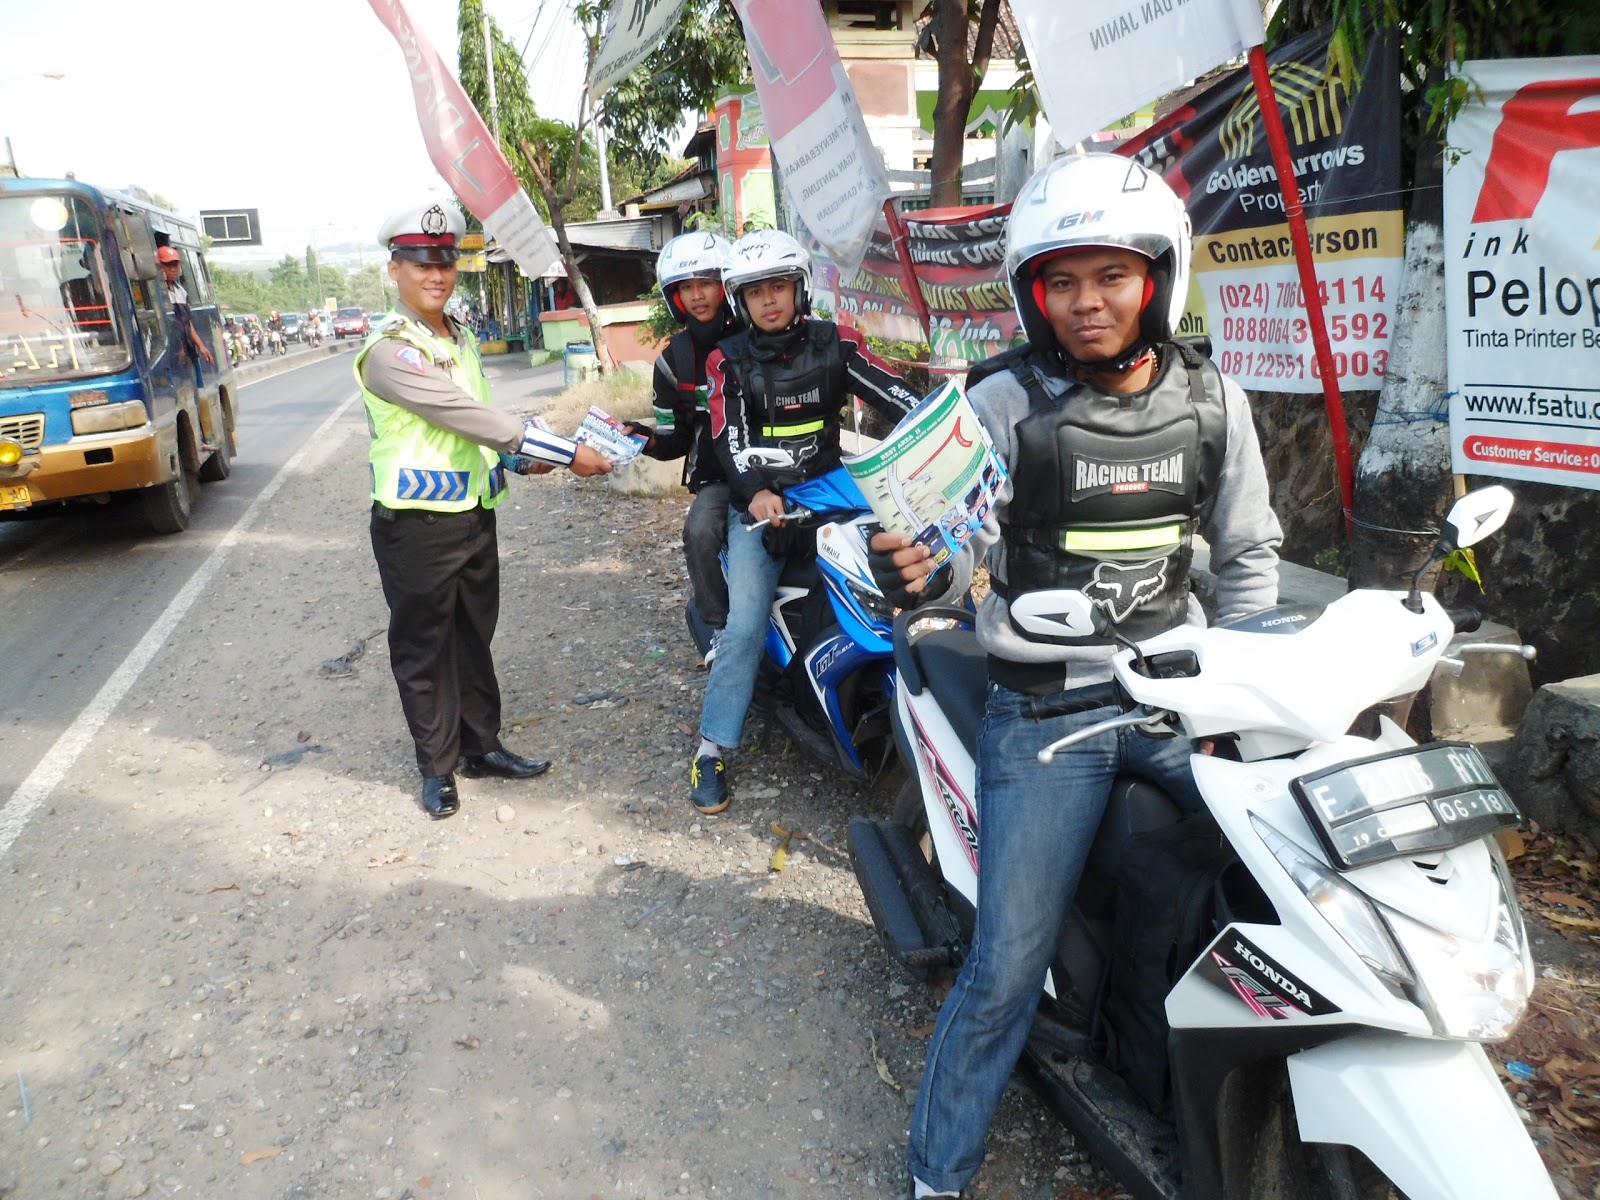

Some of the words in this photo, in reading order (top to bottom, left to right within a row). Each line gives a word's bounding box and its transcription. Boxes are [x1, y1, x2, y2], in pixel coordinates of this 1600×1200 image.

[1206, 164, 1277, 194] Golden
[1239, 180, 1322, 213] Proert
[1057, 209, 1105, 231] GM
[1308, 227, 1378, 256] rson
[1462, 227, 1530, 258] ink
[1219, 282, 1270, 314] (024)
[1223, 313, 1388, 344] 08880643592
[1463, 329, 1509, 348] Tinta
[1514, 328, 1577, 349] Printer
[797, 387, 820, 404] TEAM
[897, 434, 914, 450] AREA
[1472, 441, 1532, 461] Customer
[1534, 447, 1582, 467] Service
[1075, 459, 1138, 491] RACING
[1142, 452, 1183, 484] TEAM
[1115, 483, 1146, 492] PRODUCT
[820, 541, 841, 561] YAMAHA
[1260, 613, 1307, 629] HONDA
[1233, 939, 1313, 1009] HONDA
